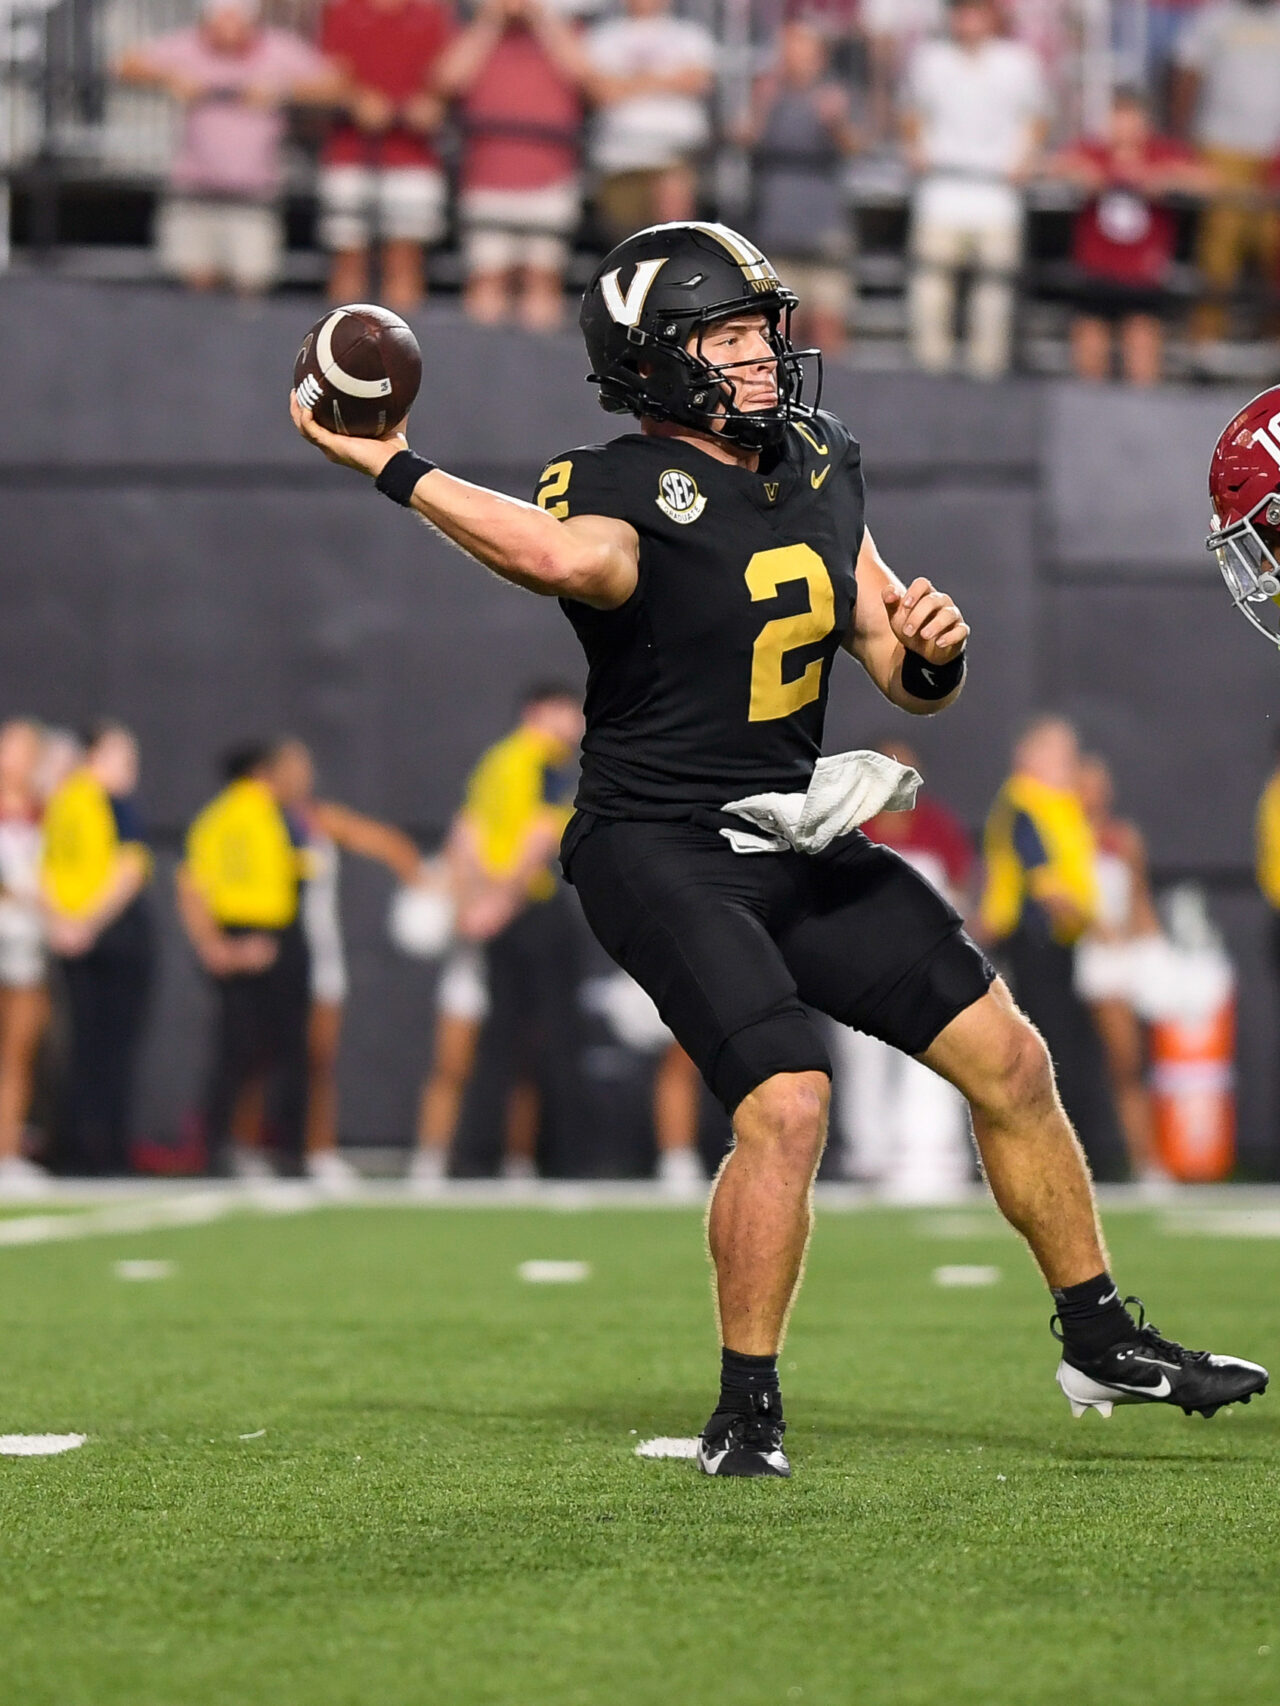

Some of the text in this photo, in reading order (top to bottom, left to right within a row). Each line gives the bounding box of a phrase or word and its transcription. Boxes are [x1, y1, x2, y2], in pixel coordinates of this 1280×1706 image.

[600, 257, 669, 328] V
[537, 460, 573, 520] 2
[662, 472, 694, 509] SEC
[763, 482, 779, 502] V
[744, 542, 836, 722] 2
